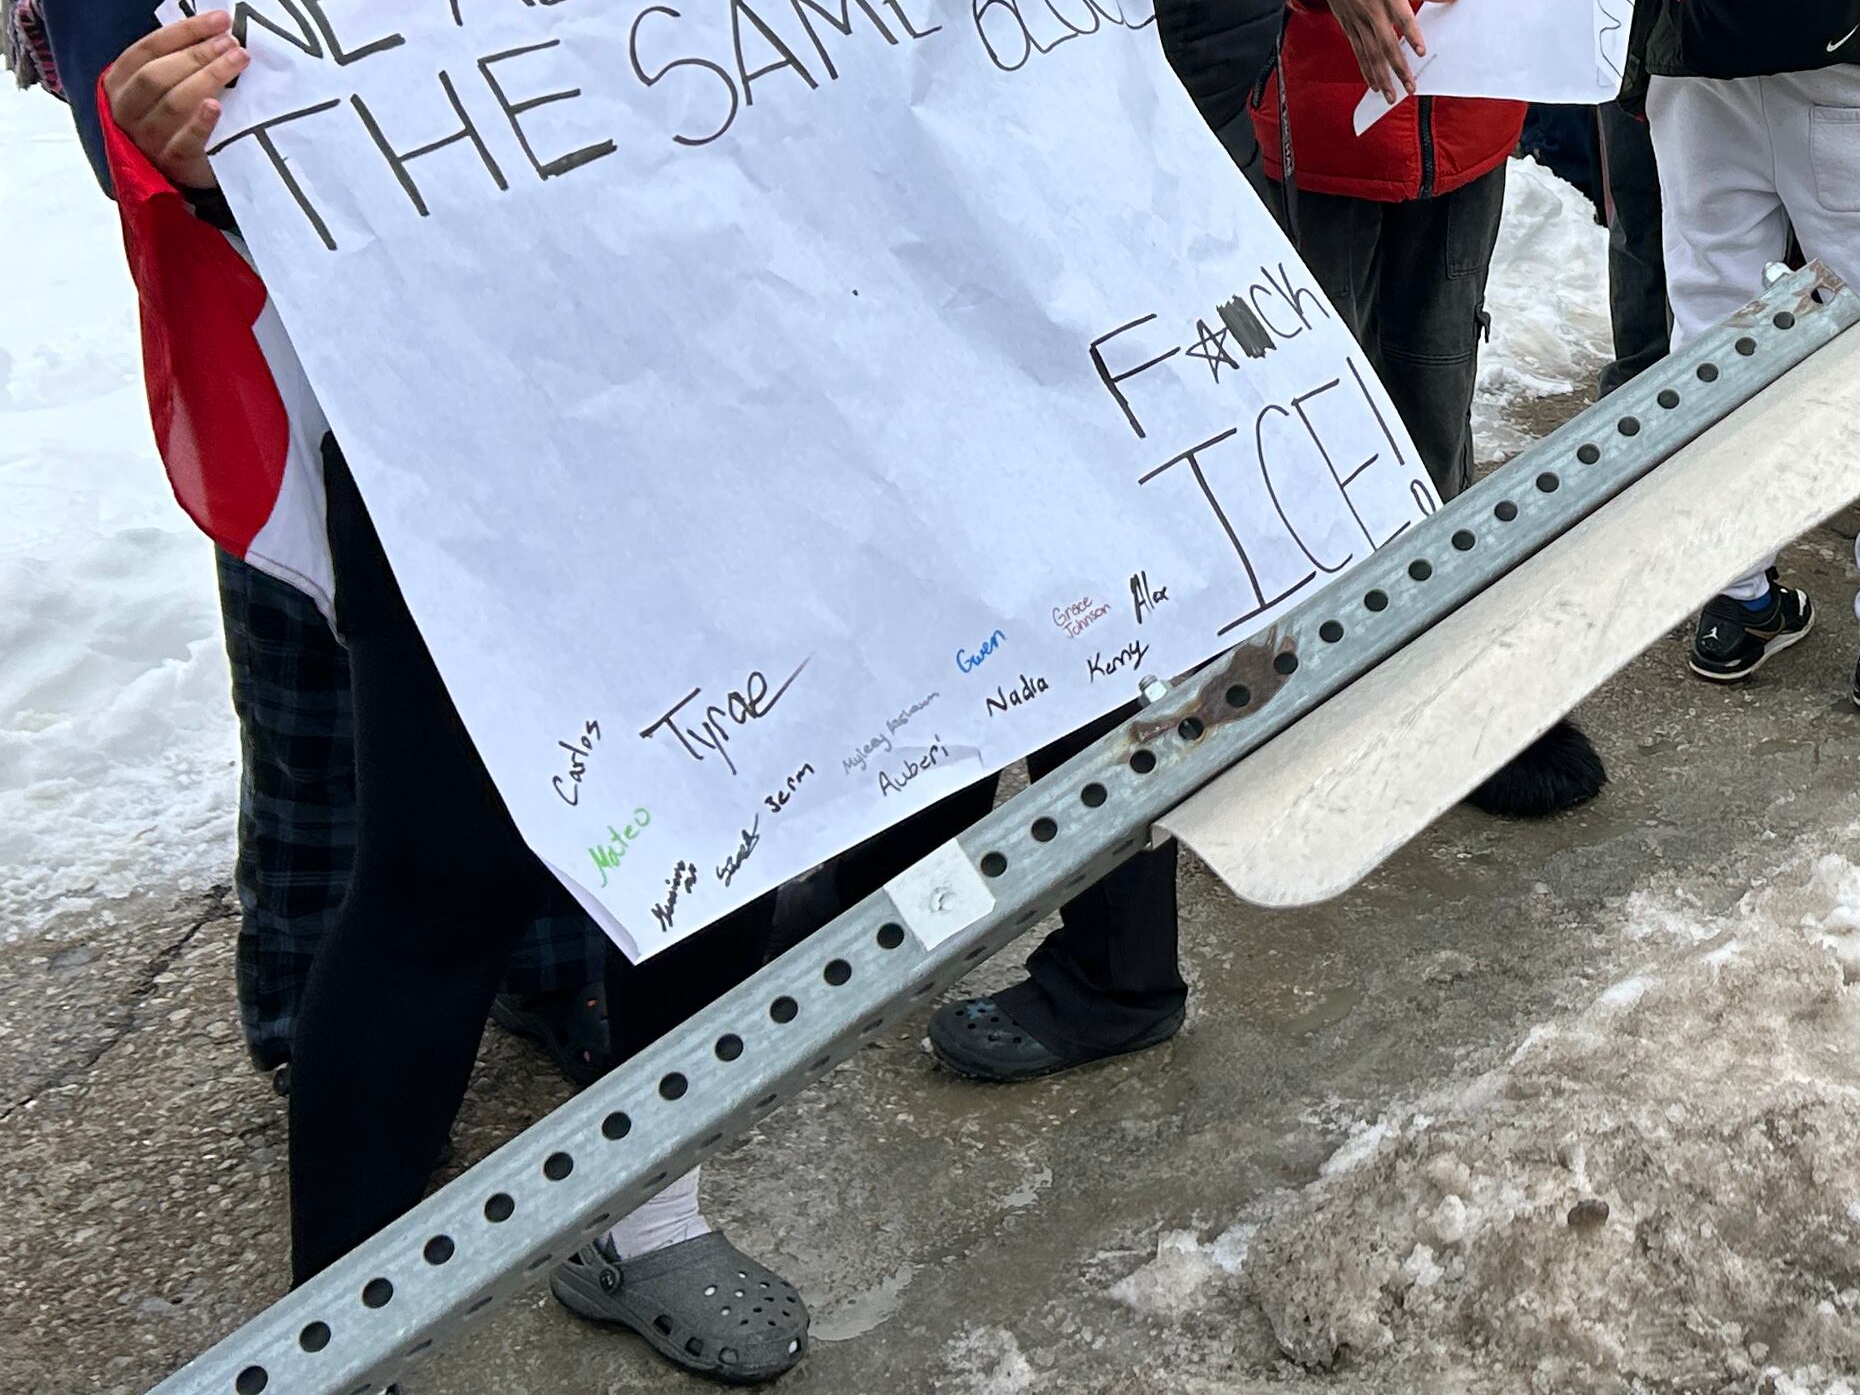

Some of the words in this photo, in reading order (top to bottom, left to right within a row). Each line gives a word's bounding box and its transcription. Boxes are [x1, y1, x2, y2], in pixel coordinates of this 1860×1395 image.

[206, 38, 618, 251] THE
[1139, 357, 1437, 638] ICE!
[1052, 597, 1093, 627] Grace
[1063, 603, 1112, 639] Johnson
[956, 629, 1008, 674] Gwen
[985, 674, 1049, 717] Nadia
[552, 720, 601, 807] Carlos
[588, 807, 651, 889] Mateo
